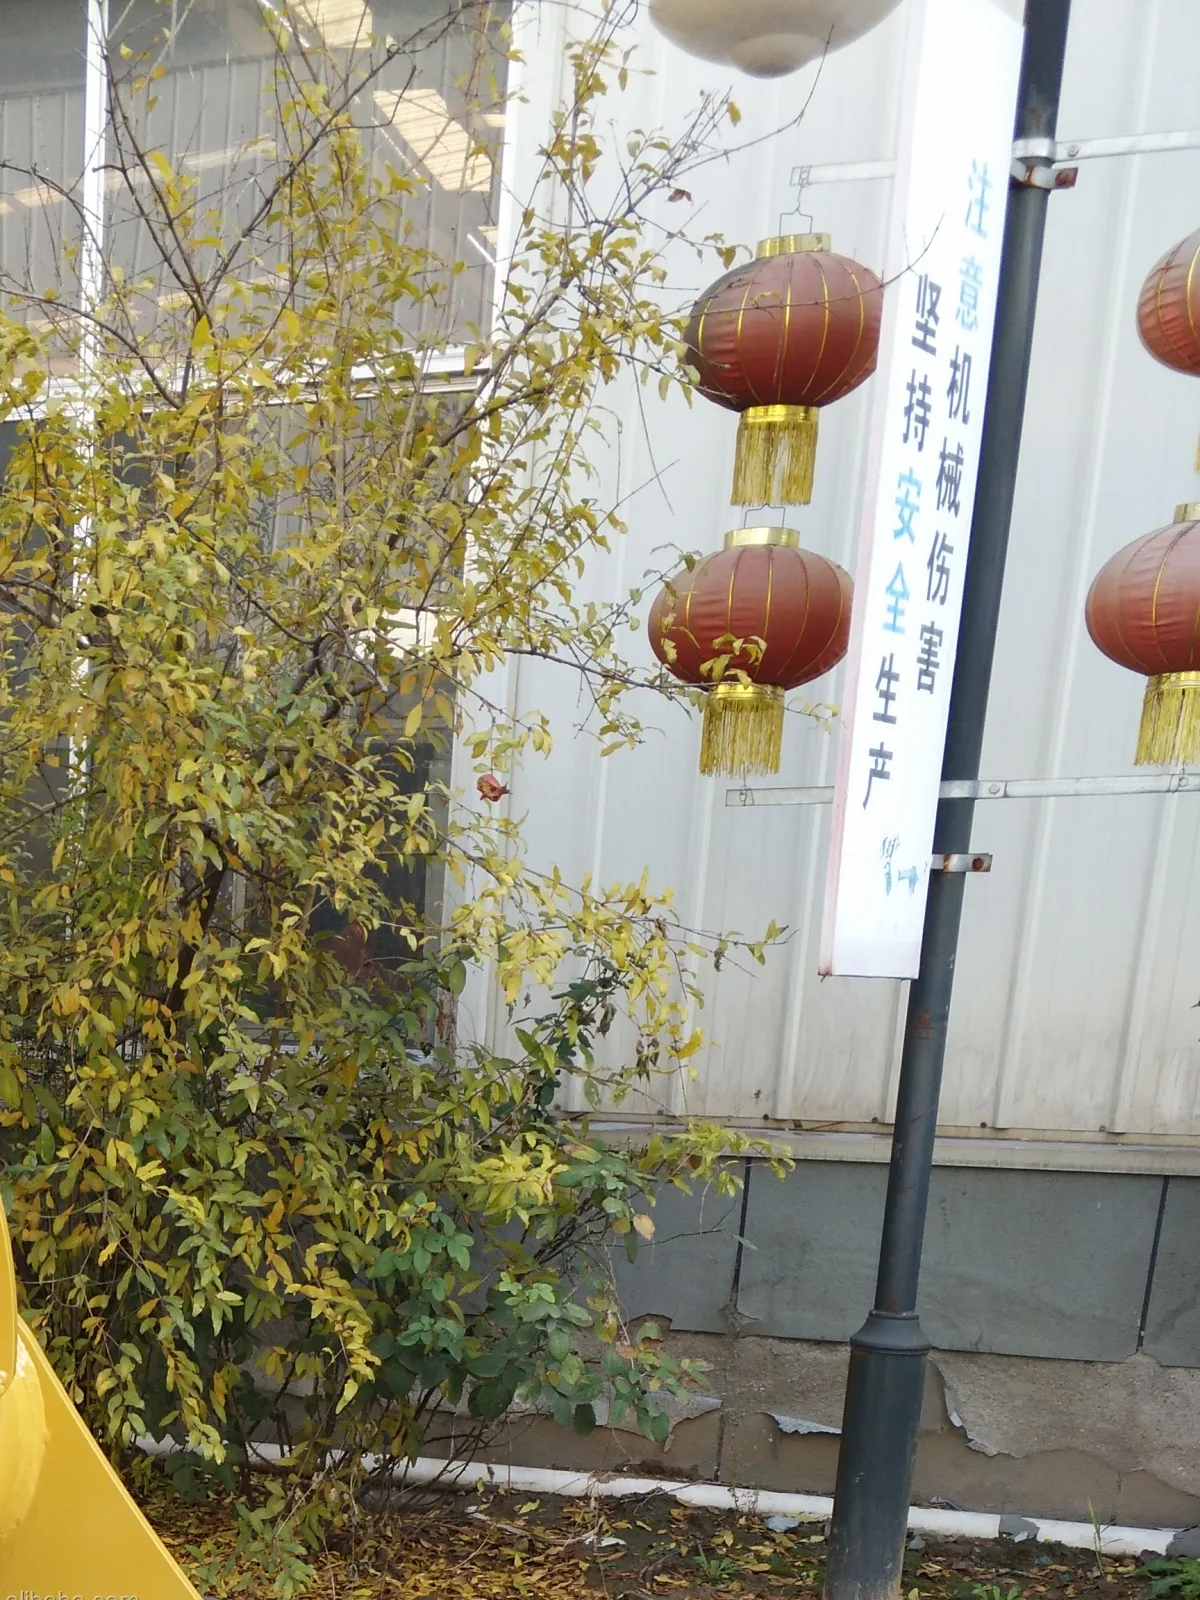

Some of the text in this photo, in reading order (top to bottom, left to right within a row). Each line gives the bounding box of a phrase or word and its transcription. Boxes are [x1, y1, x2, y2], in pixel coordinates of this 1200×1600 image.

[862, 273, 942, 810] 坚持安全生产
[916, 157, 993, 696] 注意机械伤害
